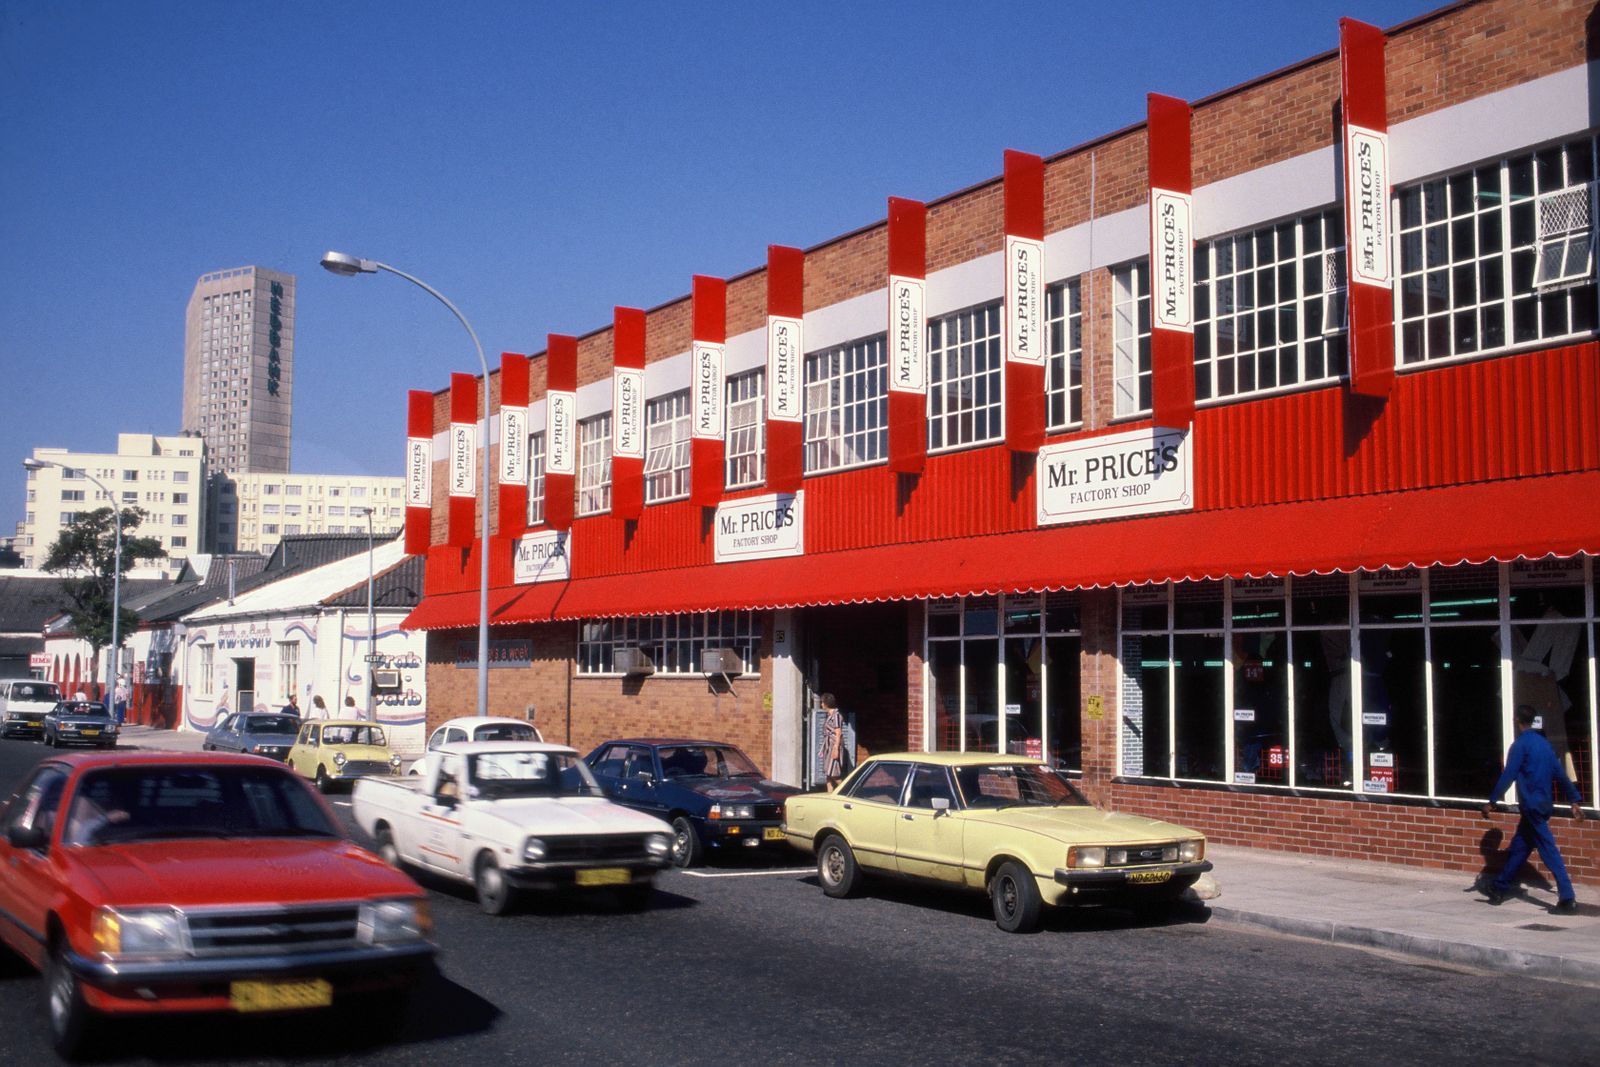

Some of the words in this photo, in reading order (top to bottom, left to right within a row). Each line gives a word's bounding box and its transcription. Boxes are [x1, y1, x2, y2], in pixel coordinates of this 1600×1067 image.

[1358, 141, 1373, 233] PRICE'S
[1162, 203, 1175, 282] PRICE'S
[1363, 236, 1375, 272] Mr.
[1166, 286, 1177, 318] Mr.
[899, 287, 910, 353] PRICE'S
[776, 326, 788, 385] PRICE'S
[1018, 324, 1028, 353] Mr.
[700, 352, 711, 404] PRICE'S
[901, 356, 910, 382] Mr.
[621, 377, 631, 425] PRICE'S
[778, 388, 788, 412] Mr.
[506, 414, 516, 456] PRICE'S
[553, 398, 563, 445] PRICE'S
[701, 407, 711, 429] Mr.
[456, 430, 465, 470] PRICE'S
[622, 428, 631, 448] Mr.
[413, 444, 422, 482] PRICE'S
[507, 458, 515, 476] Mr.
[554, 447, 562, 466] Mr.
[1047, 462, 1078, 489] Mr.
[1084, 440, 1179, 484] PRICE'S
[413, 483, 421, 499] Mr.
[1070, 487, 1119, 505] FACTORY
[1122, 483, 1151, 498] SHOP
[720, 515, 739, 535] Mr.
[741, 503, 794, 533] PRICE'S
[733, 536, 759, 548] FACTORY
[760, 534, 778, 545] SHOP
